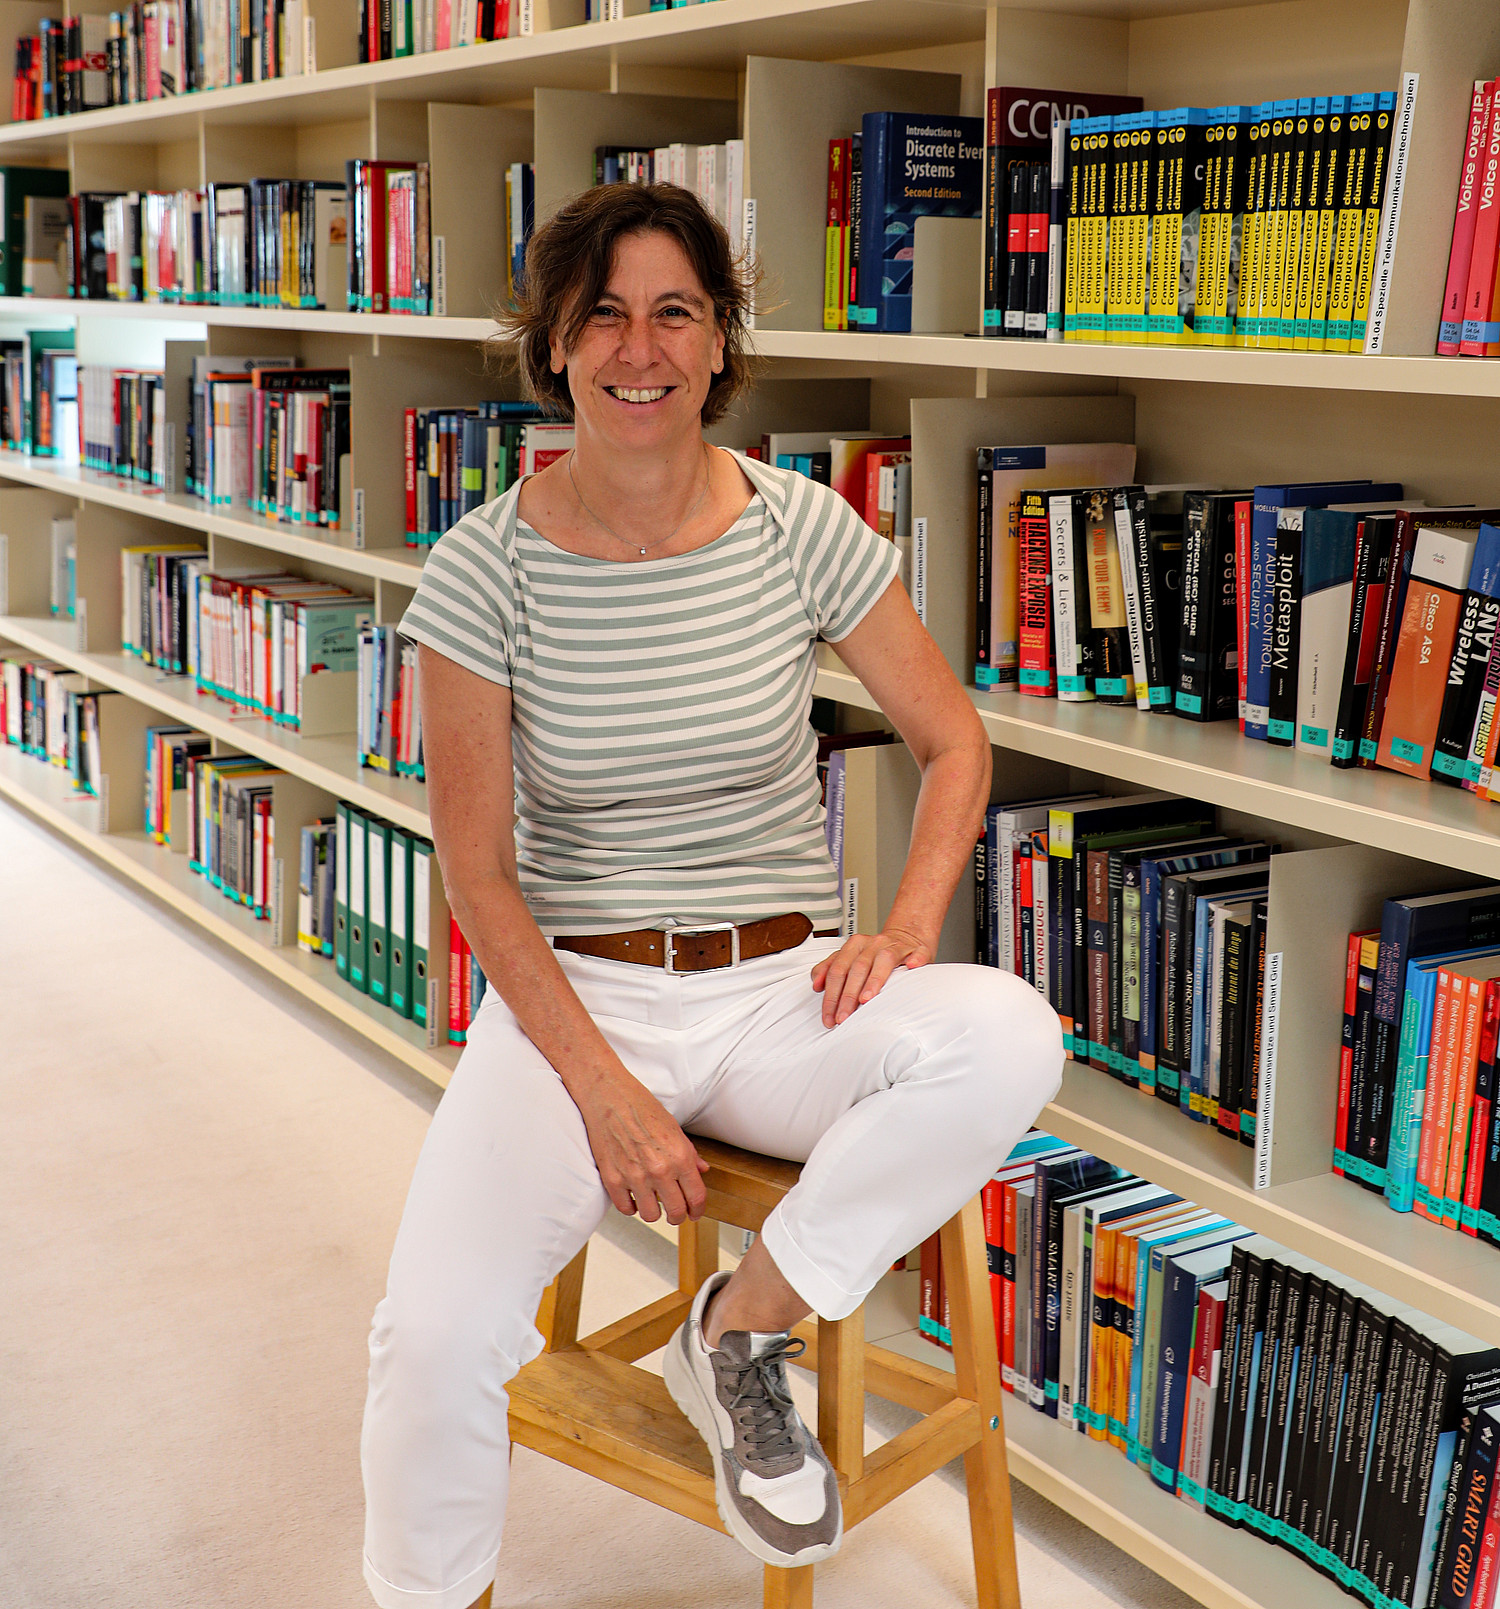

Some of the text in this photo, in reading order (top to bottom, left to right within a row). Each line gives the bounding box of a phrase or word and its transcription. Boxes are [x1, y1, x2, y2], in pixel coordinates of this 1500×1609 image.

[906, 124, 962, 138] Introduction to
[990, 98, 998, 121] CCNP
[1481, 95, 1492, 132] Technik
[905, 160, 956, 181] Systems
[906, 139, 956, 159] Discrete
[1458, 93, 1484, 213] Voice over IP
[904, 186, 962, 199] Second Edition
[988, 186, 996, 207] Study
[988, 207, 996, 228] Guide
[1371, 78, 1416, 349] 04.04 Spezielle Telekommunikationstechnologien
[1479, 157, 1499, 211] Voice
[1067, 221, 1077, 303] Computernetze
[1095, 219, 1104, 303] Computernetze
[1125, 219, 1135, 304] Computernetze
[1135, 219, 1145, 304] Computernetze
[1150, 218, 1160, 305] Computernetze
[1168, 217, 1178, 305] Computernetze
[1205, 217, 1217, 305] Computernetze
[1216, 217, 1229, 306] Computernetze
[1271, 215, 1284, 307] Computernetze
[1285, 214, 1298, 307] Computernetze
[1300, 214, 1314, 308] Computernetze
[1315, 214, 1330, 308] Computernetze
[1332, 213, 1347, 308] Computernetze
[1342, 213, 1358, 309] Computernetze
[1358, 213, 1375, 309] Computernetze
[406, 414, 414, 491] Data Mining
[1023, 506, 1045, 516] Edition
[1254, 504, 1279, 513] MOELLER
[1414, 521, 1464, 531] Step-by-Step
[916, 522, 924, 589] Datensicherheit
[1028, 521, 1047, 576] HACKING
[1056, 519, 1069, 616] Secrets & Lies
[1092, 528, 1111, 614] KNOW YOUR ENEMY
[1135, 518, 1155, 632] Computer-Forensik
[1185, 537, 1194, 574] TO THE
[1191, 530, 1201, 575] OFFICIAL
[1391, 558, 1400, 584] Firewall
[1394, 542, 1402, 558] ASA
[1027, 576, 1047, 629] EXPOSED
[1189, 604, 1198, 637] GUIDE
[1250, 563, 1262, 630] SECURITY
[1259, 536, 1278, 675] IT AUDIT, CONTROL,
[1272, 552, 1298, 669] Metasploit
[1352, 543, 1371, 633] PRIVACY ENGINEERING
[1384, 584, 1396, 628] Fundamentals
[1419, 592, 1432, 628] Third Edition
[1126, 591, 1141, 664] IT-Sicherheit
[1378, 640, 1387, 664] Edition
[1418, 593, 1441, 665] Cisco ASA
[1448, 595, 1480, 685] Wireless
[1471, 602, 1500, 662] LANs
[836, 768, 846, 815] Artificial
[976, 844, 986, 882] RFID
[847, 883, 856, 918] Systeme
[1036, 899, 1045, 976] HANDBUCH
[1129, 915, 1137, 972] MOBILE WIRELESS
[1226, 930, 1241, 1005] Internet der Dinge
[1257, 949, 1265, 971] GSM
[1377, 942, 1387, 987] CONTROL
[1095, 953, 1105, 1012] Energy Harvesting
[1166, 931, 1177, 1052] Mobile Ad Hoc Networking
[1183, 969, 1193, 1059] AD HOC NETWORKING
[1253, 981, 1264, 1052] LTE-ADVANCED
[1374, 989, 1384, 1016] SYSTEMS
[1380, 946, 1394, 1019] INFORMATION AND
[1387, 942, 1401, 1022] WEB BASED ENERGY
[1251, 1053, 1259, 1075] PRO
[1259, 954, 1279, 1187] 04.08 Energieinformationsnetze und Smart Grids
[1424, 993, 1447, 1121] Elektrische Energieverteilung
[1437, 998, 1460, 1128] Elektrische Energieverteilung
[1454, 1003, 1477, 1134] Elektrische Energieverteilung
[1250, 1087, 1258, 1100] 5G
[1490, 1144, 1498, 1162] GRID
[1491, 1119, 1500, 1143] SMART
[1046, 1240, 1058, 1332] SMART GRID
[1065, 1268, 1075, 1322] smart city
[1160, 1370, 1174, 1444] Elektroenergiesysteme
[1463, 1383, 1471, 1393] A
[1465, 1371, 1491, 1381] Christian
[1445, 1461, 1463, 1515] Smart Grid
[1451, 1469, 1487, 1598] SMART GRID
